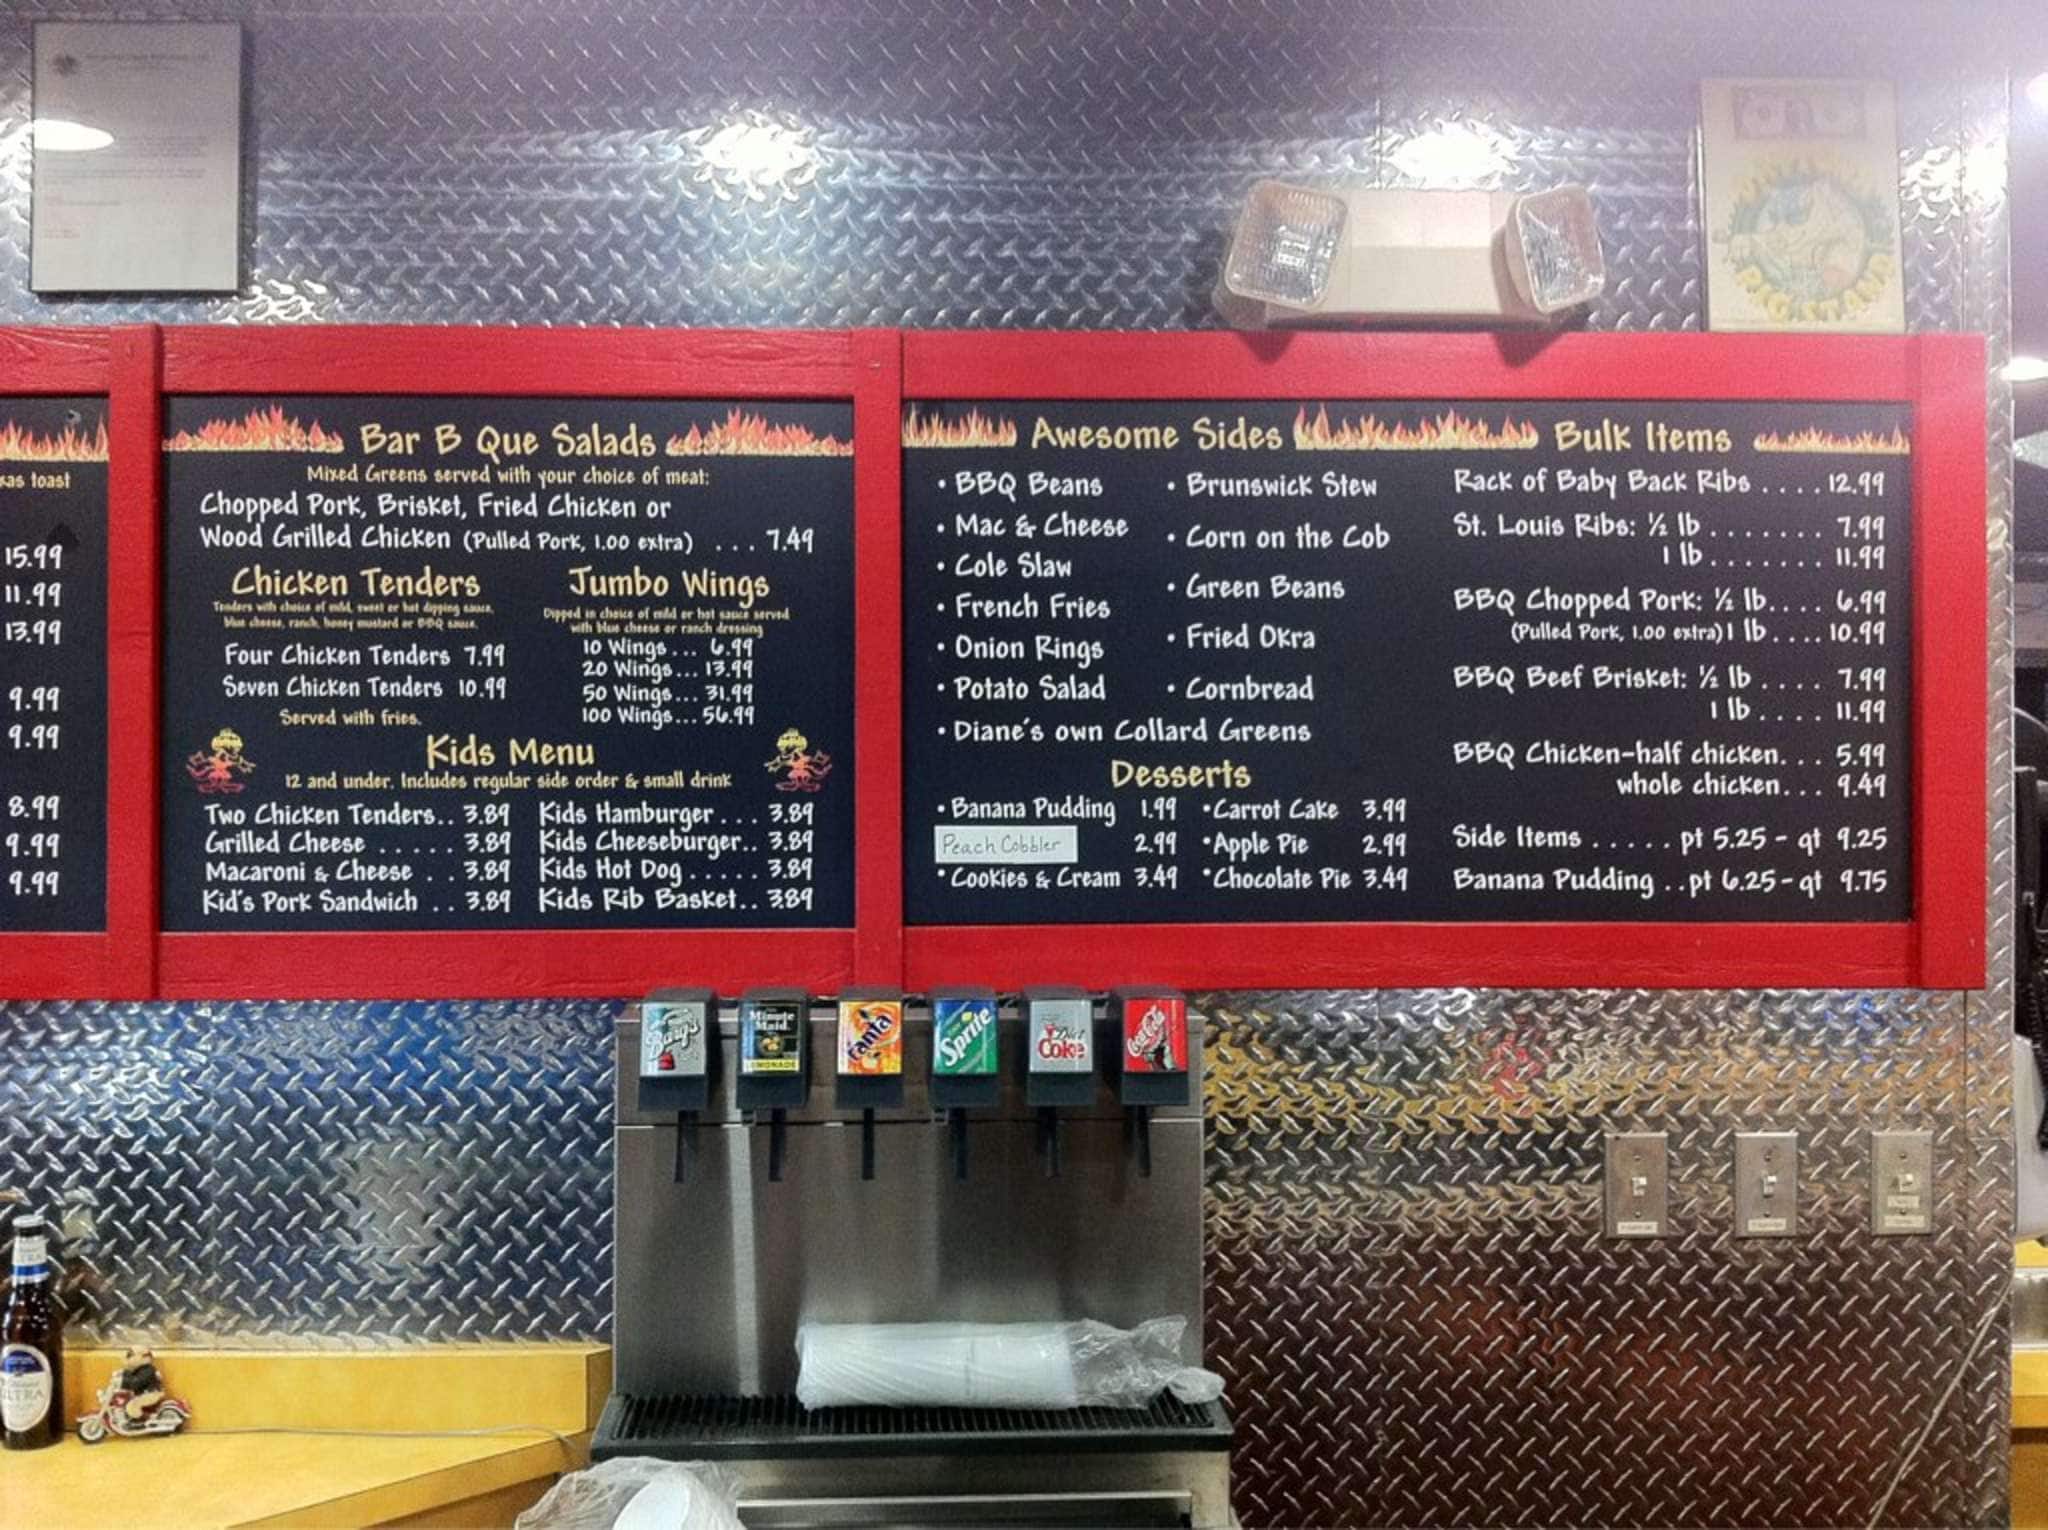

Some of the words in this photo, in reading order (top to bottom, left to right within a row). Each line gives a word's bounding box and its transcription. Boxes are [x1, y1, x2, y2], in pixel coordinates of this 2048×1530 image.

[359, 423, 420, 455] Bar
[434, 424, 462, 455] B
[476, 425, 539, 464] Que
[551, 422, 656, 457] Salads
[1031, 417, 1179, 449] Awesome
[1192, 416, 1283, 450] Sides
[1554, 418, 1631, 451] Bulk
[1645, 421, 1732, 452] Items
[30, 472, 71, 489] toast
[306, 463, 358, 482] Mixed
[364, 463, 427, 482] Greens
[433, 464, 490, 483] served
[496, 464, 531, 483] with
[537, 470, 576, 489] your
[582, 465, 635, 484] choice
[641, 465, 660, 485] of
[954, 471, 1016, 502] BBQ
[1027, 471, 1103, 496] Beans
[1186, 472, 1312, 497] Brunswick
[1321, 471, 1377, 497] Stew
[1453, 469, 1512, 493] Rack
[1521, 467, 1548, 492] of
[1555, 467, 1617, 500] Baby
[1627, 469, 1687, 492] Back
[1696, 468, 1751, 494] Ribs
[1828, 471, 1884, 496] 12.99
[199, 490, 298, 523] Chopped
[305, 493, 366, 519] Pork,
[376, 493, 467, 520] Brisket,
[477, 492, 538, 517] Fried
[547, 492, 636, 518] Chicken
[645, 501, 671, 518] or
[955, 513, 1006, 536] Mac
[1014, 514, 1037, 538] &
[1043, 511, 1129, 537] Cheese
[1185, 525, 1246, 548] Corn
[1255, 530, 1285, 548] on
[1295, 522, 1333, 549] the
[1342, 523, 1390, 549] Cob
[1452, 512, 1486, 536] St.
[1497, 514, 1564, 536] Louis
[1573, 512, 1635, 538] Ribs:
[1677, 512, 1700, 536] lb
[1836, 515, 1885, 540] 7.99
[199, 523, 263, 548] Wood
[271, 523, 351, 548] Grilled
[360, 523, 450, 548] Chicken
[462, 530, 530, 553] (Pulled
[536, 532, 585, 552] Pork,
[594, 534, 630, 550] 1.00
[637, 531, 693, 555] extra)
[765, 526, 813, 553] 7.49
[4, 544, 62, 569] 15.99
[1662, 546, 1669, 564] 1
[1679, 541, 1702, 566] lb
[1835, 545, 1885, 569] 11.99
[231, 564, 347, 596] Chicken
[359, 565, 480, 597] Tenders
[568, 565, 669, 596] Jumbo
[681, 568, 770, 609] Wings
[4, 582, 61, 607] 11.99
[5, 620, 61, 645] 13.99
[1510, 622, 1572, 643] (Pulled
[1577, 623, 1624, 642] Pork,
[1632, 625, 1666, 640] 1.00
[1672, 622, 1723, 644] extra)
[1726, 622, 1733, 640] 1
[1743, 617, 1767, 642] lb
[1829, 621, 1885, 645] 10.99
[224, 642, 273, 665] Four
[280, 643, 361, 665] Chicken
[367, 643, 450, 666] Tenders
[463, 644, 505, 666] 7.99
[1185, 675, 1314, 701] Cornbread
[1452, 666, 1515, 694] BBQ
[1525, 664, 1584, 689] Beef
[1591, 666, 1686, 688] Brisket:
[1727, 664, 1751, 688] lb
[1837, 667, 1886, 692] 7.99
[8, 686, 59, 711] 9.99
[278, 708, 336, 725] Served
[341, 709, 375, 725] with
[953, 717, 1044, 741] Diane's
[1054, 725, 1103, 741] own
[1114, 717, 1208, 742] Collard
[1218, 717, 1311, 742] Greens
[7, 724, 59, 749] 9.99
[426, 733, 495, 770] Kids
[509, 738, 594, 766] Menu
[284, 774, 302, 788] 12
[306, 771, 337, 789] and
[400, 771, 467, 789] Includes
[472, 771, 531, 795] regular
[536, 770, 569, 788] side
[574, 770, 619, 788] order
[624, 773, 639, 789] &
[642, 770, 684, 788] small
[689, 770, 731, 788] drink
[1111, 759, 1251, 788] Desserts
[7, 795, 59, 820] 8.99
[538, 801, 587, 827] Kids
[595, 800, 714, 832] Hamburger
[767, 802, 813, 825] 3.89
[950, 797, 1026, 818] Banana
[1032, 795, 1116, 827] Pudding
[1141, 797, 1177, 820] 1.99
[1212, 798, 1281, 820] Carrot
[1288, 798, 1339, 819] Cake
[1361, 798, 1406, 822] 3.99
[5, 833, 60, 858] 9.99
[942, 832, 996, 854] Peach
[1000, 833, 1062, 854] Cobbler
[8, 871, 59, 896] 9.99
[205, 861, 305, 882] Macaroni
[313, 866, 329, 883] &
[335, 858, 413, 881] Cheese
[463, 859, 510, 883] 3.89
[202, 889, 255, 915] Kid's
[260, 891, 312, 912] Pork
[318, 888, 417, 912] Sandwich
[464, 889, 511, 913] 3.89
[848, 1014, 892, 1060] Fanta
[940, 1008, 993, 1067] Sprite
[1038, 1038, 1085, 1060] Coke
